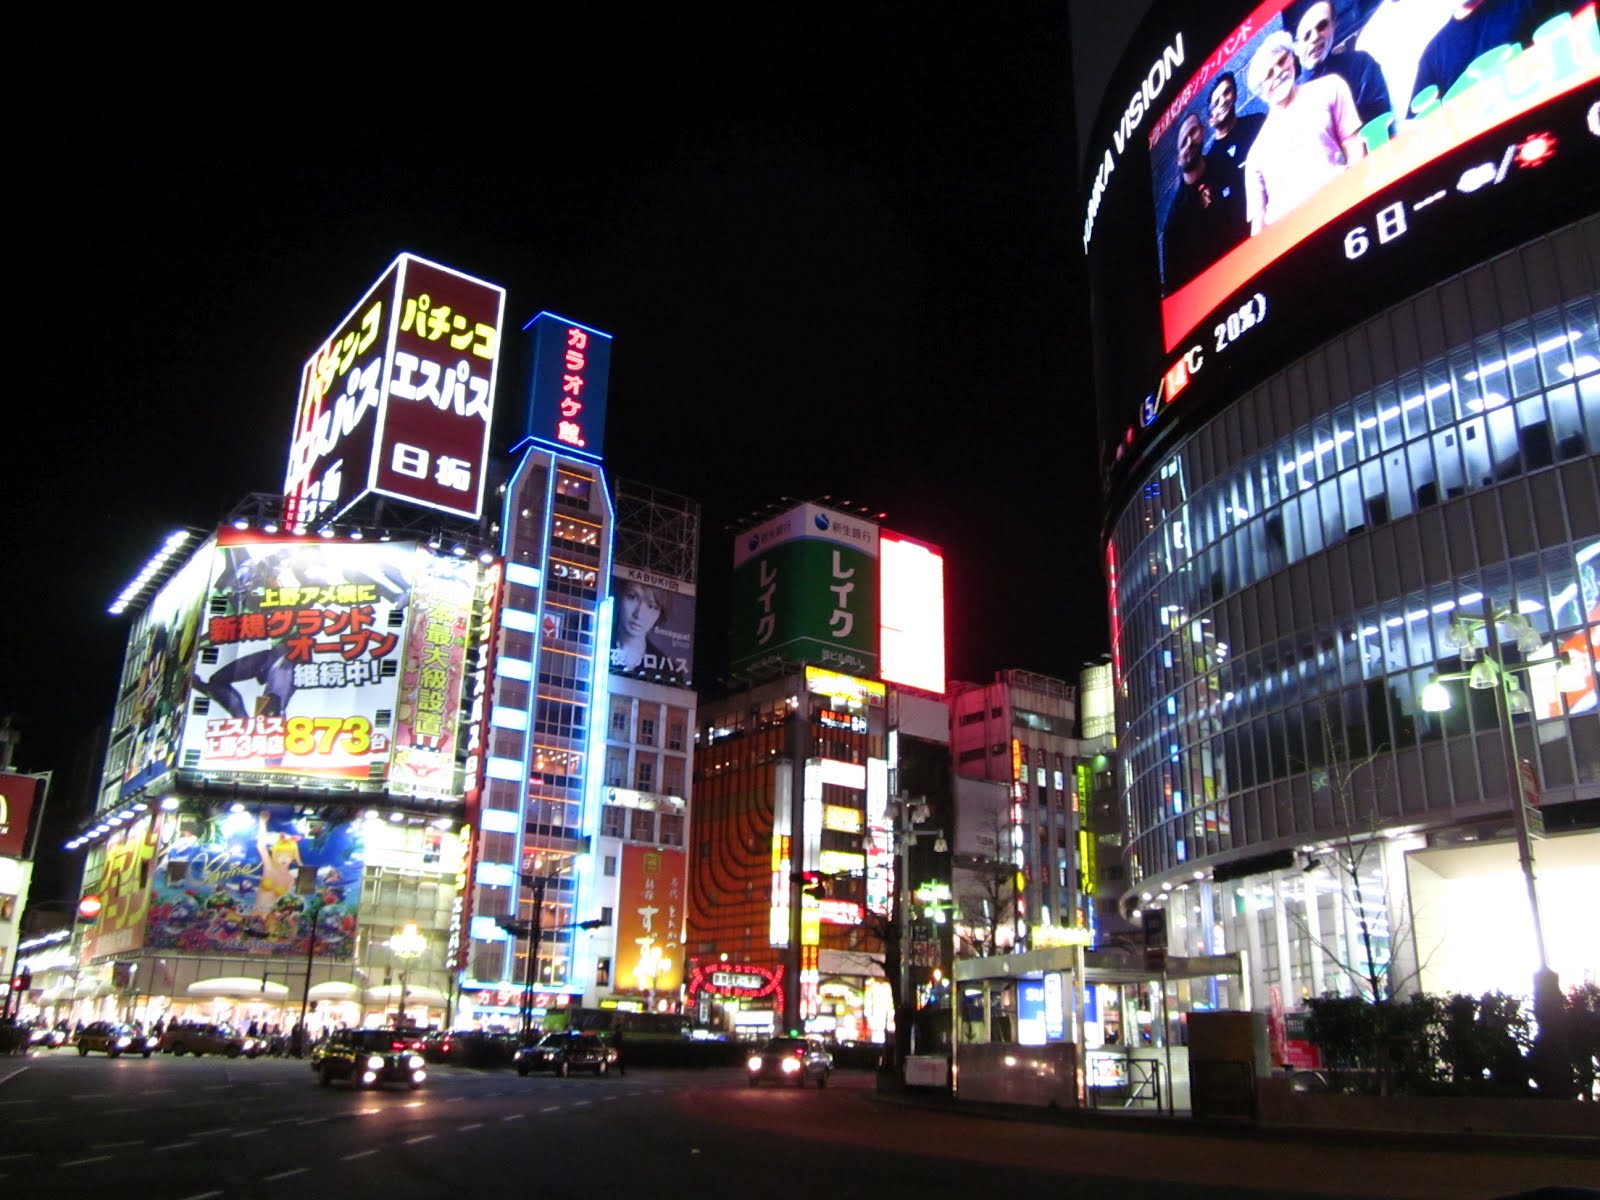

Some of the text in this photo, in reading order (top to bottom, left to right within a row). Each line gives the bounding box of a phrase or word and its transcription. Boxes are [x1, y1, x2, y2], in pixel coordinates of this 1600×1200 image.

[1113, 32, 1184, 154] VISION
[401, 294, 496, 359] パチンコ
[390, 352, 489, 422] エスパス
[832, 520, 871, 544] 新生銀行
[757, 560, 777, 645] レイク
[829, 550, 855, 638] レイク
[209, 605, 376, 643] 新規グランド
[286, 631, 399, 666] オープン
[610, 648, 689, 674] 夜ロハス
[205, 715, 285, 737] エスパス
